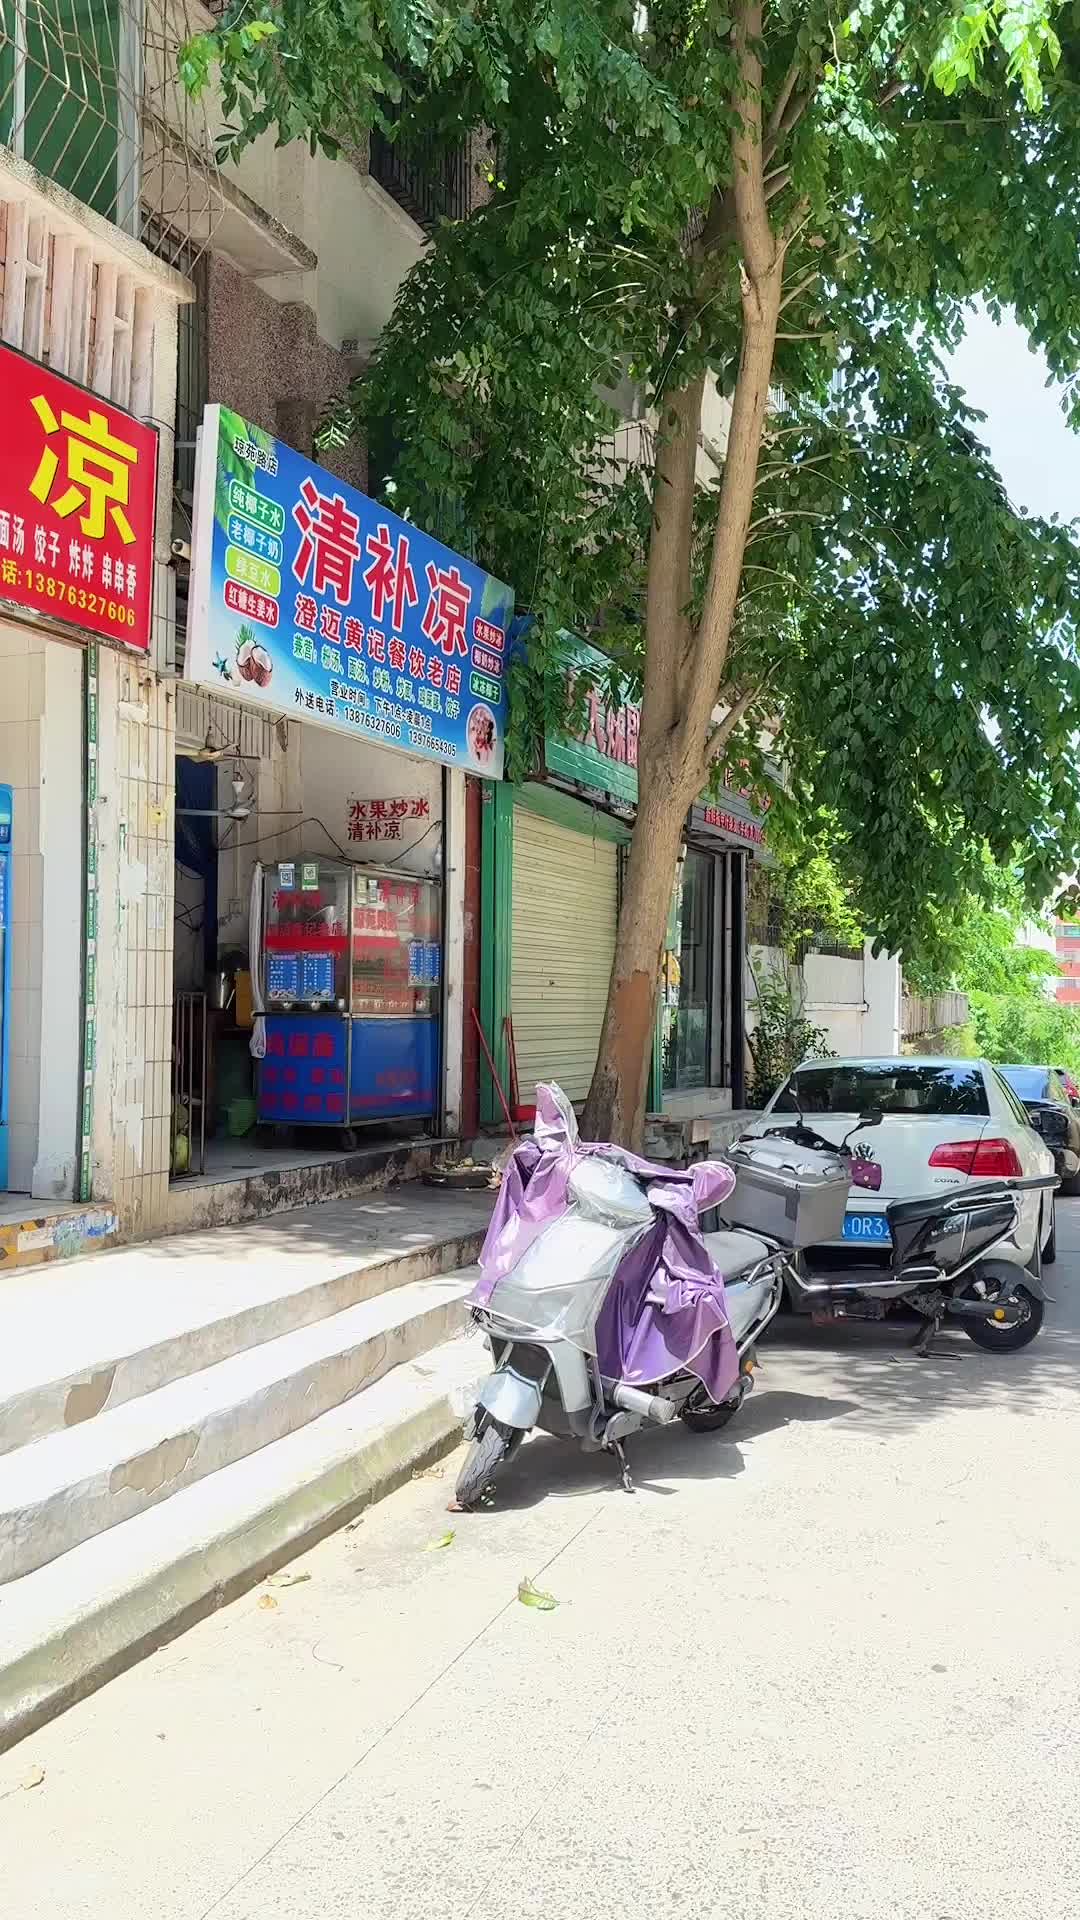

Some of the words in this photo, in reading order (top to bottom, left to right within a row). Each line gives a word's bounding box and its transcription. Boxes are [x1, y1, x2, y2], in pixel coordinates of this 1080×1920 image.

[28, 394, 138, 545] 凉
[232, 485, 281, 528] 纯椰子水
[230, 518, 279, 561] 老椰子奶
[34, 523, 61, 569] 饺子
[102, 551, 137, 601] 串串香
[235, 556, 272, 588] 绿豆水
[291, 476, 472, 658] 清补凉
[227, 585, 276, 623] 红糖生姜水
[294, 592, 461, 696] 澄迈黄记餐饮老店
[408, 729, 457, 757] 13976654305
[349, 798, 430, 819] 水果炒冰
[347, 821, 401, 841] 清补凉
